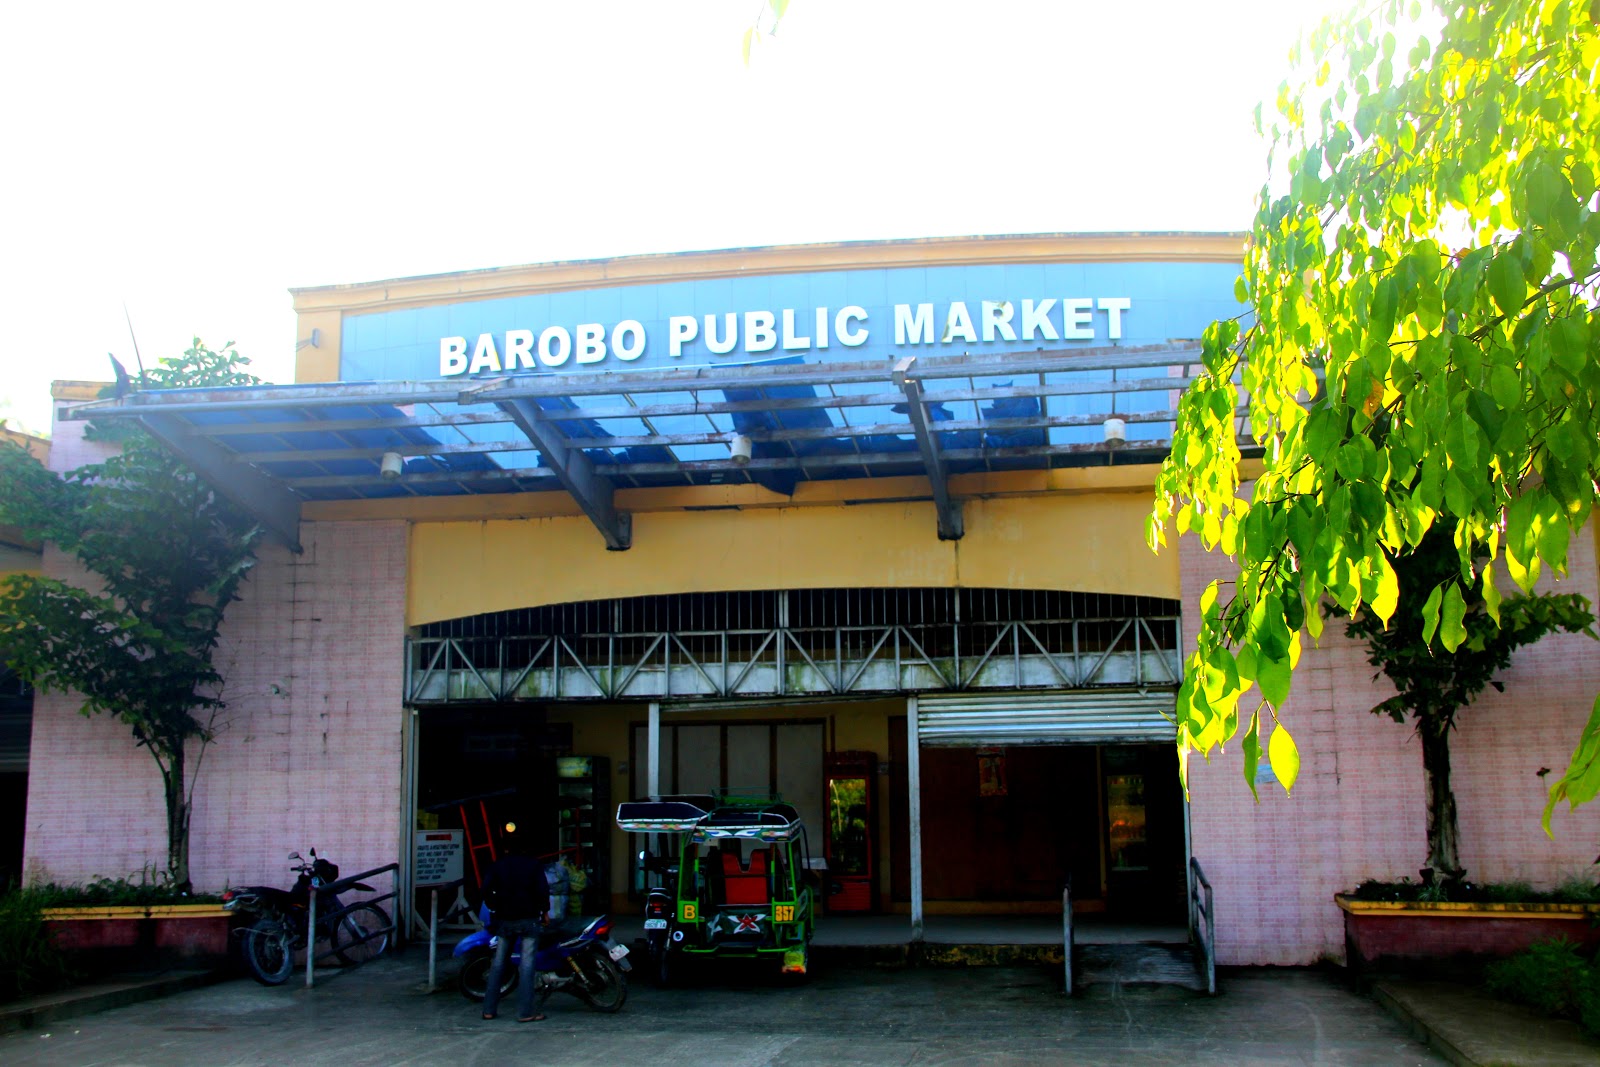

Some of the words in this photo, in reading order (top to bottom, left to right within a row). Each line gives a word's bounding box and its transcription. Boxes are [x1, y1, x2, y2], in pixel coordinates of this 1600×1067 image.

[439, 319, 647, 377] BAROBO
[669, 305, 870, 357] PUBLIC
[894, 297, 1131, 345] MARKET
[683, 904, 696, 920] B
[775, 905, 795, 921] 357
